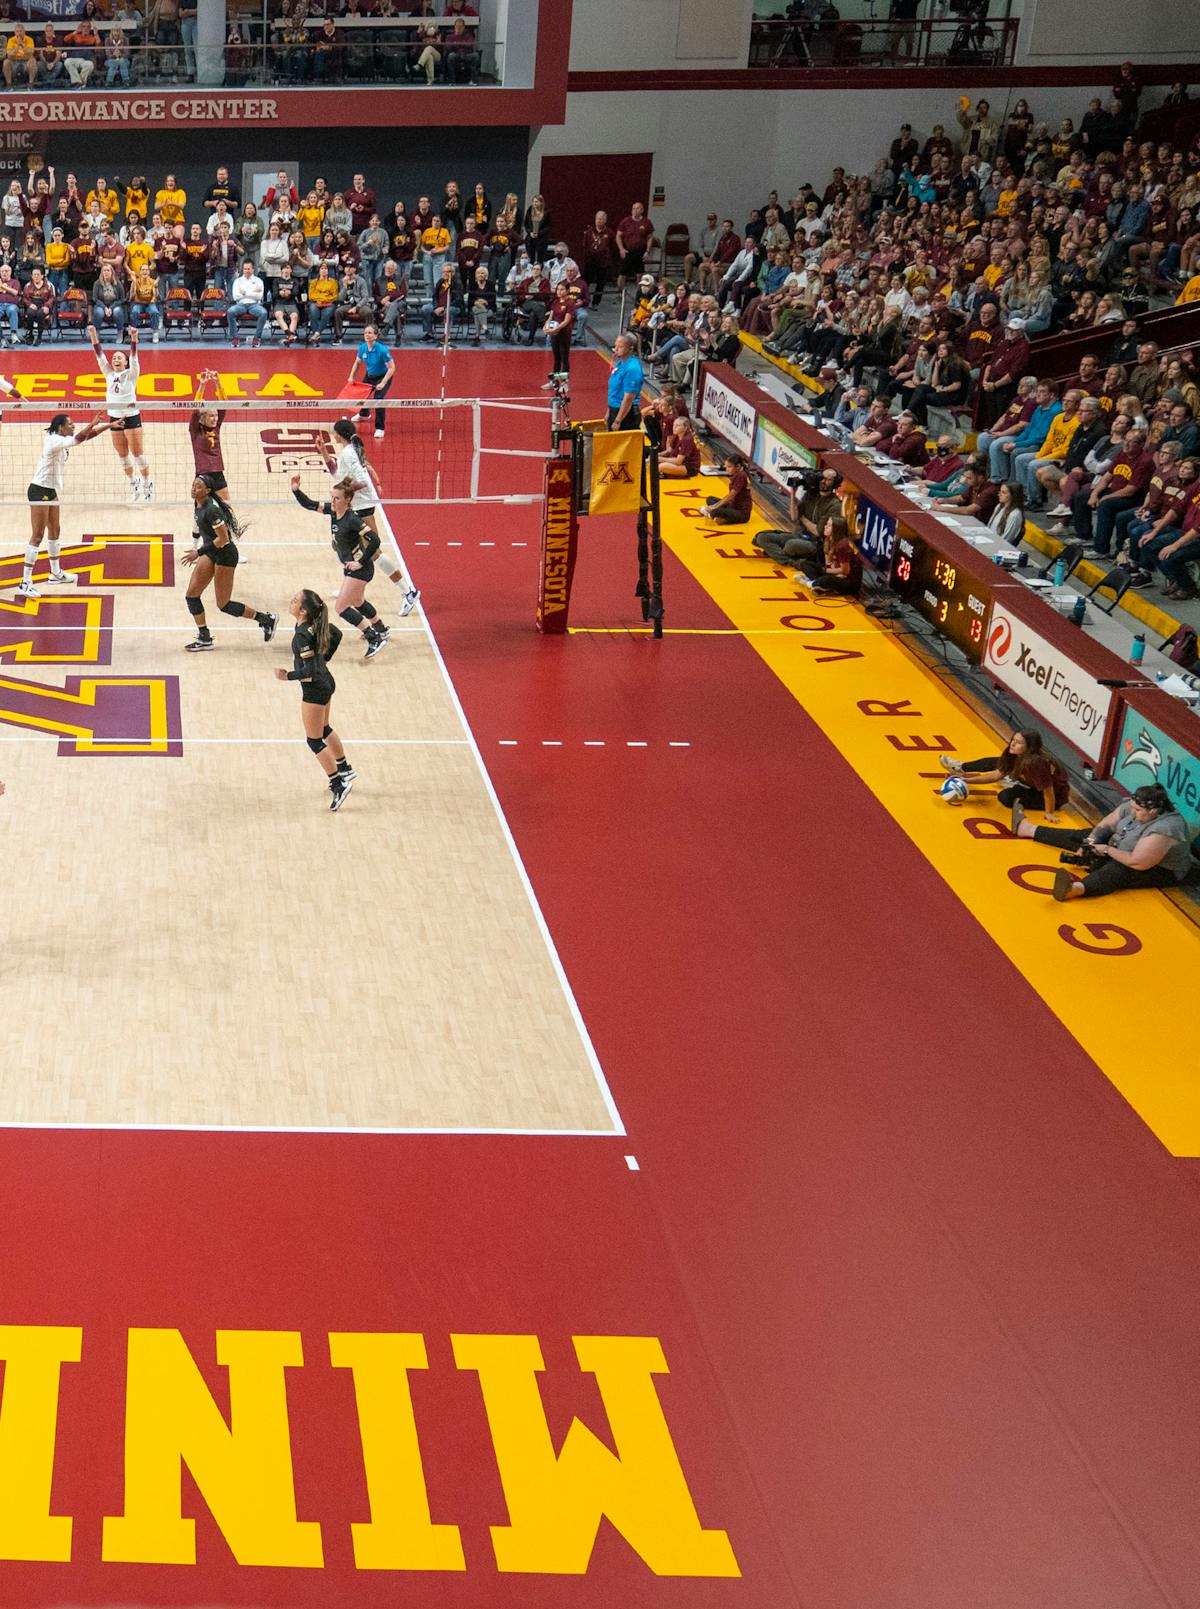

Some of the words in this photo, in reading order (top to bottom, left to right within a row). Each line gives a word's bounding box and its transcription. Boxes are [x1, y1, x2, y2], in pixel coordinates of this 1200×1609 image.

[170, 99, 279, 120] CENTER
[6, 132, 34, 148] INC.
[114, 383, 120, 394] 6
[544, 496, 572, 616] MINNESOTA
[897, 556, 911, 581] 20
[935, 559, 957, 590] 1:30
[940, 601, 949, 622] 3
[967, 593, 986, 617] GUEST
[970, 618, 983, 643] 13
[1014, 642, 1053, 690] Xcel
[1049, 670, 1103, 737] Energy
[1166, 754, 1200, 814] We
